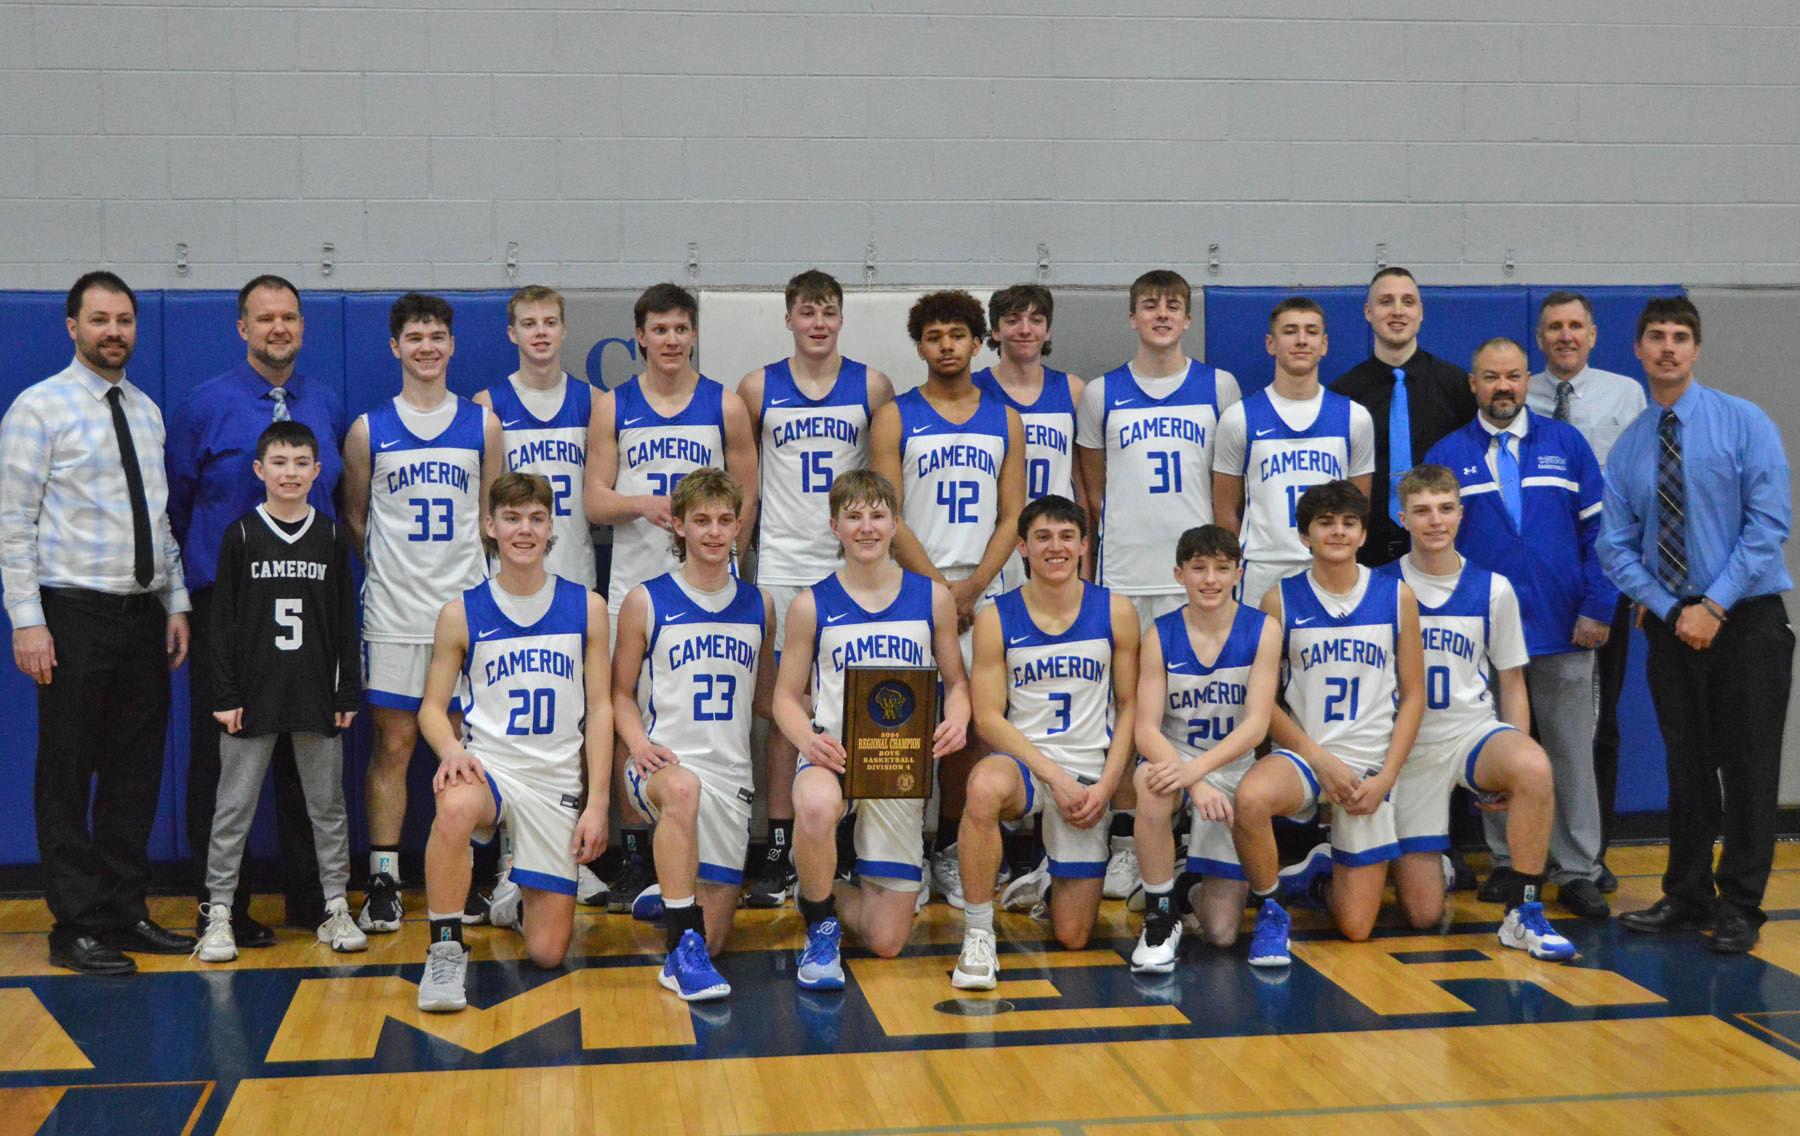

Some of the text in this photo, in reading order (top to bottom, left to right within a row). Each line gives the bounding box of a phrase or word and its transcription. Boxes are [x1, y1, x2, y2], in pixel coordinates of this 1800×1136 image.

[773, 416, 859, 448] CAMERON
[1025, 424, 1067, 456] ERON
[1120, 416, 1205, 449] CAMERON
[627, 437, 711, 469] CAMERON
[800, 450, 834, 493] 15
[918, 445, 997, 478] CAMERON
[1146, 451, 1182, 494] 31
[1260, 449, 1342, 482] CAMERON
[388, 460, 470, 495] CAMERON
[544, 475, 571, 516] 2
[1025, 458, 1050, 499] 0
[408, 498, 454, 541] 33
[936, 480, 980, 524] 42
[1285, 485, 1312, 527] 1
[251, 560, 327, 580] CAMERON
[275, 598, 303, 650] 5
[485, 648, 574, 687] CAMERON
[669, 634, 756, 673] CAMERON
[832, 635, 924, 672] CAMERON
[1013, 655, 1105, 688] CAMERON
[1301, 638, 1387, 672] CAMERON
[693, 674, 736, 721] 23
[1324, 677, 1360, 723] 21
[1427, 665, 1450, 709] 0
[506, 687, 556, 735] 20
[1047, 692, 1071, 735] 3
[858, 738, 921, 749] REGIONAL CHAMPION
